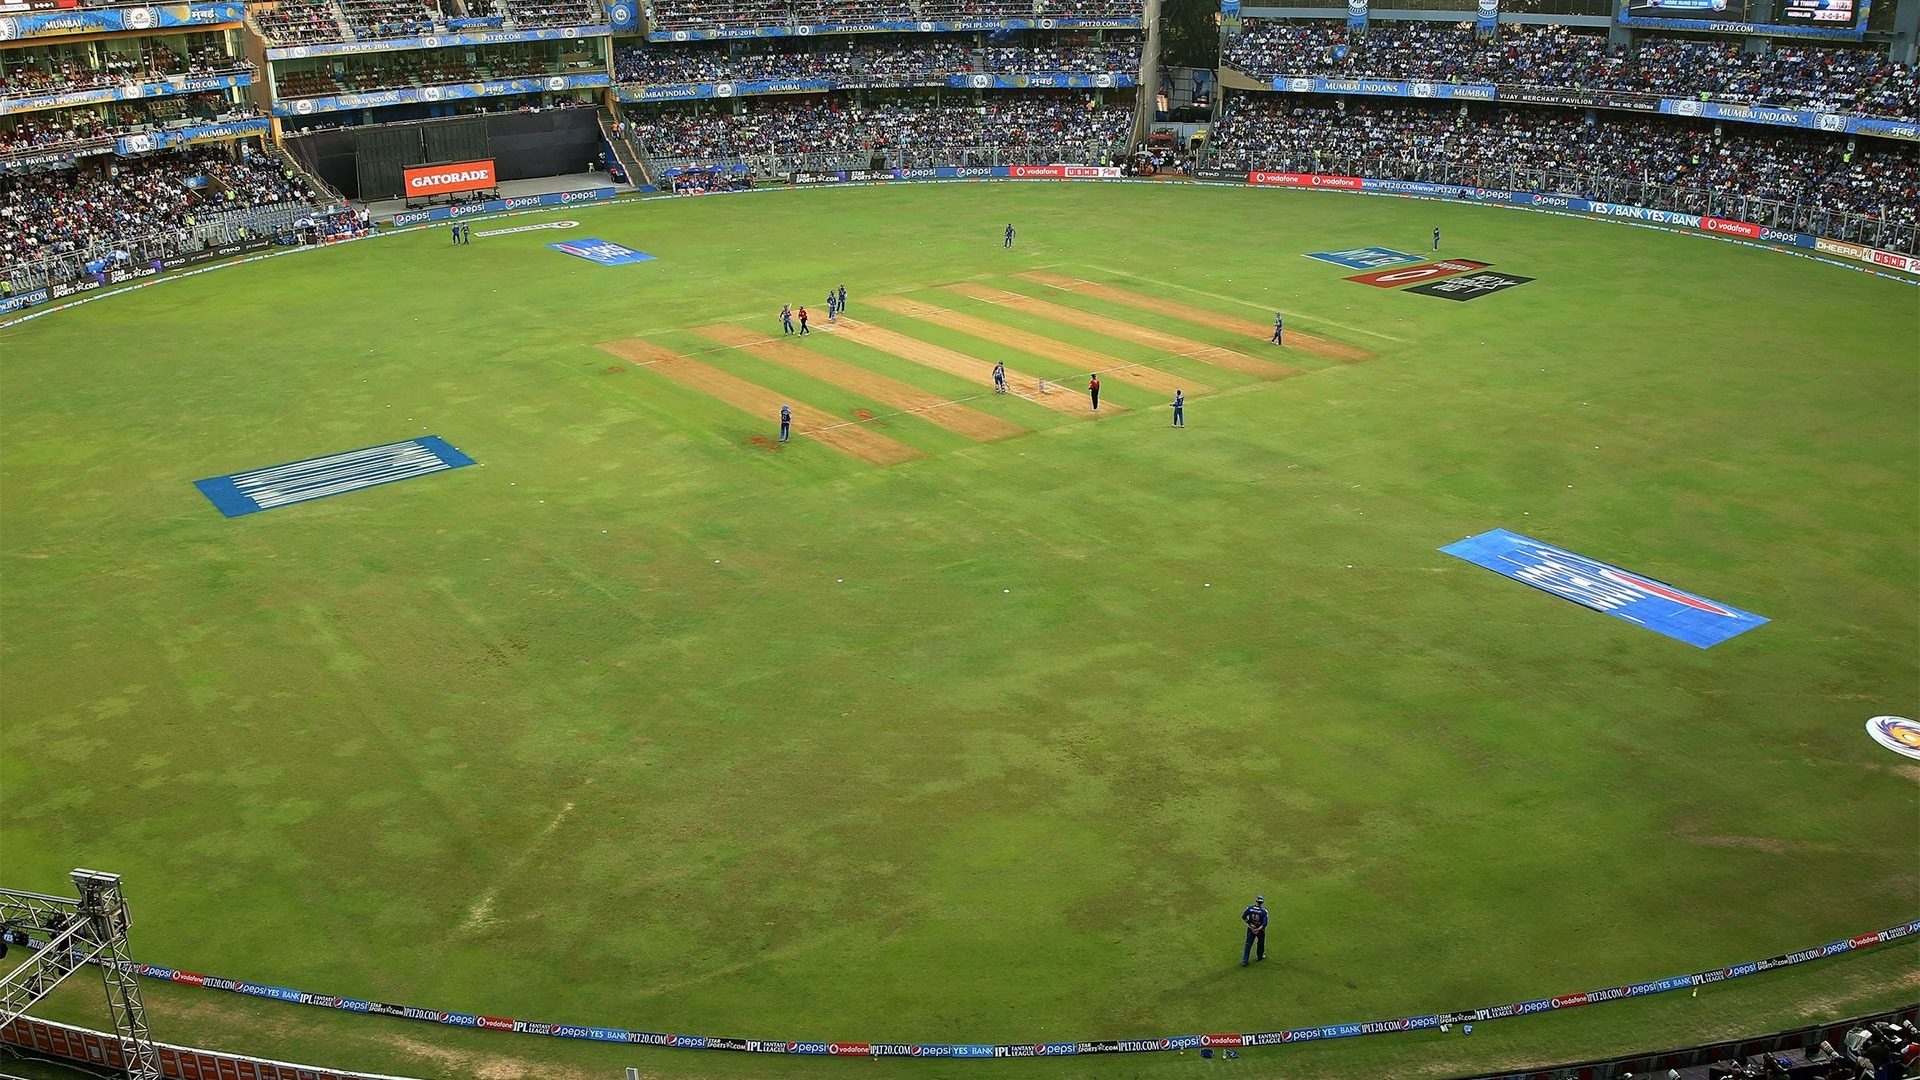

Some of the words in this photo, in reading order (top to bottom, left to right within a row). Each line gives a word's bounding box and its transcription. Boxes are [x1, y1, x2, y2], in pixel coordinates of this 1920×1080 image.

[45, 20, 82, 30] MUMBAI
[1079, 20, 1118, 28] IPLT20.COM
[1710, 23, 1754, 33] IPLT20.COM
[176, 79, 220, 91] IPLT20.COM
[769, 82, 800, 92] MUMBAI
[1323, 82, 1360, 92] MUMBAI
[1363, 84, 1398, 93] INDIANS
[633, 90, 665, 99] MUMBAI
[665, 89, 696, 97] INDIANS
[1453, 88, 1489, 98] MUMBAI
[1561, 97, 1593, 105] PAVILION
[1717, 106, 1756, 120] MUMBAI
[1758, 110, 1798, 124] INDIANS
[199, 128, 232, 138] MUMBAI
[26, 155, 59, 165] PAVILION
[911, 168, 936, 178] pepsi
[966, 166, 991, 177] pepsi
[411, 169, 489, 188] GATORADE
[1266, 174, 1299, 183] vodafone
[1322, 178, 1355, 187] vodafone
[569, 188, 597, 202] pepsi
[1485, 188, 1511, 200] pepsi
[514, 196, 541, 209] pepsi
[1541, 195, 1568, 207] pepsi
[459, 203, 485, 216] pepsi
[1588, 201, 1608, 214] YES
[1615, 207, 1645, 219] BANK
[404, 210, 430, 223] pepsi
[1645, 208, 1664, 223] YES
[1671, 214, 1700, 228] BANK
[1718, 222, 1752, 235] vodafone
[1770, 229, 1797, 243] pepsi
[1817, 241, 1863, 258] DHEERAJ
[111, 269, 125, 277] STAR
[111, 274, 133, 284] SPORTS
[53, 288, 75, 298] SPORTS
[1855, 936, 1878, 946] vodafone
[1878, 930, 1891, 942] IPL
[1827, 941, 1849, 955] pepsi
[148, 967, 172, 979] pepsi
[1734, 964, 1757, 976] pepsi
[180, 974, 203, 983] vodafone
[203, 977, 235, 990] IPLT20.COM
[1658, 981, 1671, 989] YES
[1674, 978, 1691, 987] BANK
[1692, 974, 1706, 986] IPL
[243, 984, 267, 995] pepsi
[268, 988, 280, 997] YES
[282, 991, 301, 1000] BANK
[1632, 983, 1657, 995] pepsi
[300, 993, 313, 1005] IPL
[1560, 996, 1587, 1005] vodafone
[342, 1000, 368, 1011] pepsi
[1524, 1000, 1550, 1013] pepsi
[404, 1006, 440, 1020] IPLT20.COM
[1477, 1009, 1492, 1021] IPL
[448, 1014, 475, 1026] pepsi
[486, 1020, 513, 1029] vodafone
[1411, 1016, 1437, 1028] pepsi
[513, 1021, 528, 1033] IPL
[1322, 1028, 1336, 1036] YES
[1340, 1025, 1361, 1034] BANK
[1361, 1021, 1400, 1034] IPLT20.COM
[561, 1028, 588, 1039] pepsi
[590, 1030, 603, 1038] YES
[607, 1032, 628, 1041] BANK
[628, 1033, 666, 1045] IPLT20.COM
[1293, 1030, 1320, 1040] pepsi
[677, 1036, 705, 1047] pepsi
[1171, 1037, 1199, 1048] pepsi
[1242, 1035, 1258, 1046] IPL
[747, 1041, 761, 1052] IPL
[798, 1043, 826, 1054] pepsi
[870, 1045, 911, 1056] IPLT20.COM
[922, 1046, 950, 1057] pepsi
[953, 1046, 968, 1055] YES
[972, 1046, 993, 1055] BANK
[995, 1046, 1011, 1057] IPL
[1047, 1044, 1075, 1054] pepsi
[1118, 1041, 1159, 1052] IPLT20.COM
